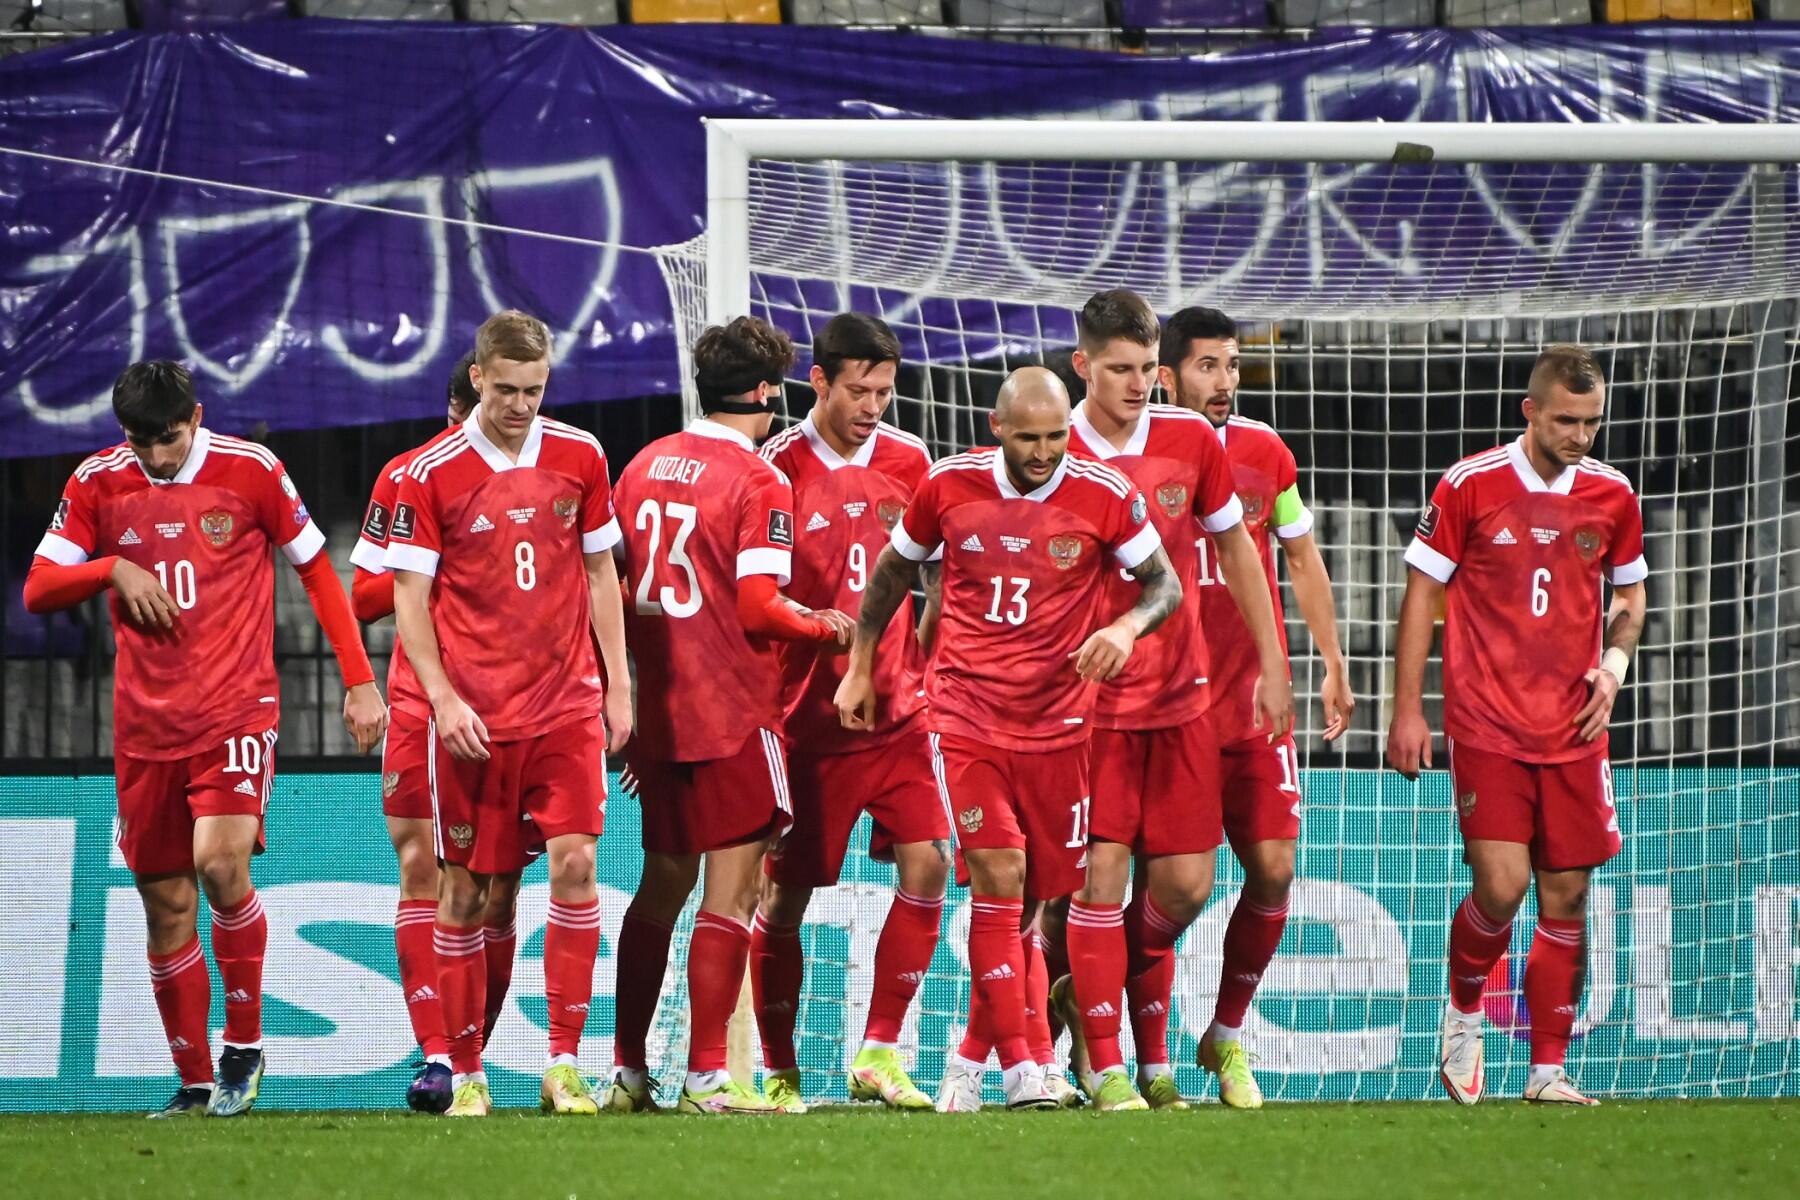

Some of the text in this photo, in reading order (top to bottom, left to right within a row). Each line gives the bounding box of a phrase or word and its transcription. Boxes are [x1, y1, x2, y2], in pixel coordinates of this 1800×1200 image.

[647, 455, 708, 486] KUZIAEV
[514, 541, 536, 591] 8
[635, 498, 703, 619] 23
[848, 543, 867, 592] 9
[1195, 537, 1226, 586] 1
[154, 559, 196, 610] 10
[984, 575, 1031, 626] 13
[1531, 567, 1552, 617] 6
[222, 735, 261, 775] 10
[1276, 744, 1300, 796] 1
